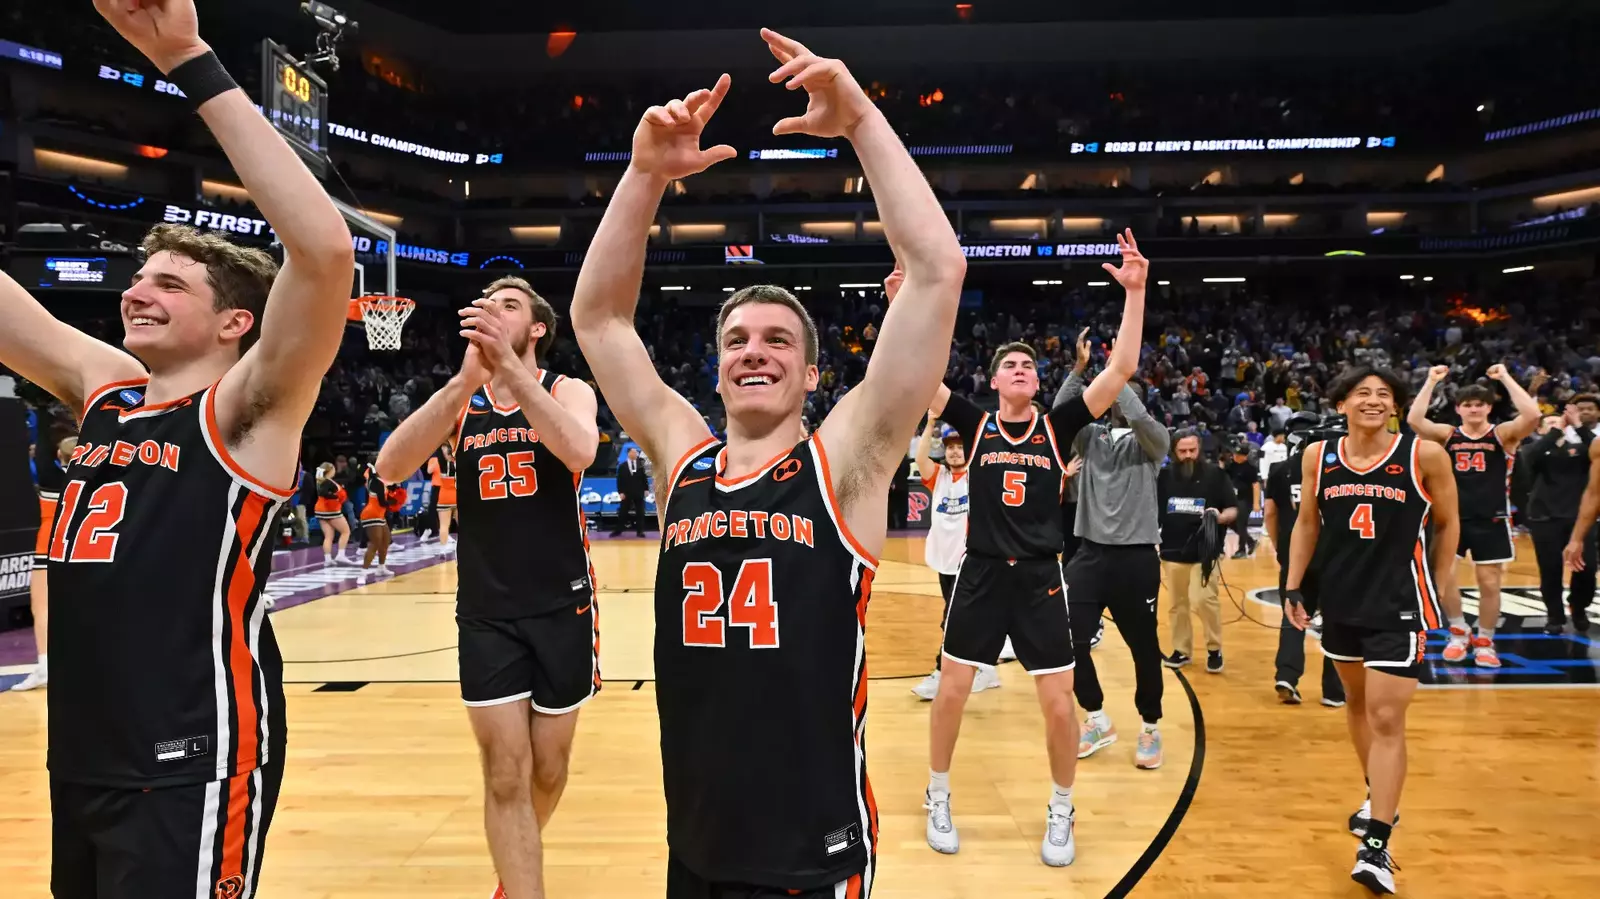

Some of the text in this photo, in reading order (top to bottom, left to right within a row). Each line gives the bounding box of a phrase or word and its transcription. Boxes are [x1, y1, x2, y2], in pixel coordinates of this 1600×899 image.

[284, 66, 310, 102] 0.0
[371, 134, 469, 164] CHAMPIONSHIP
[1104, 142, 1136, 153] 2023
[1155, 140, 1191, 152] MEN'S
[1193, 139, 1265, 151] BASKETBALL
[1267, 137, 1361, 149] CHAMPIONSHIP
[195, 210, 266, 235] FIRST
[960, 244, 1122, 257] RINCETON VS MISSOUR
[463, 428, 541, 452] PRINCETO
[980, 452, 1051, 469] PRINCETON
[1455, 451, 1486, 472] 54
[478, 451, 538, 500] 25
[1002, 471, 1027, 507] 5
[1324, 484, 1406, 503] PRINCETON
[49, 480, 129, 563] 12
[664, 510, 815, 553] PRINCETON
[1349, 503, 1376, 539] 4
[682, 558, 780, 649] 24
[193, 742, 201, 751] L
[849, 831, 856, 841] L
